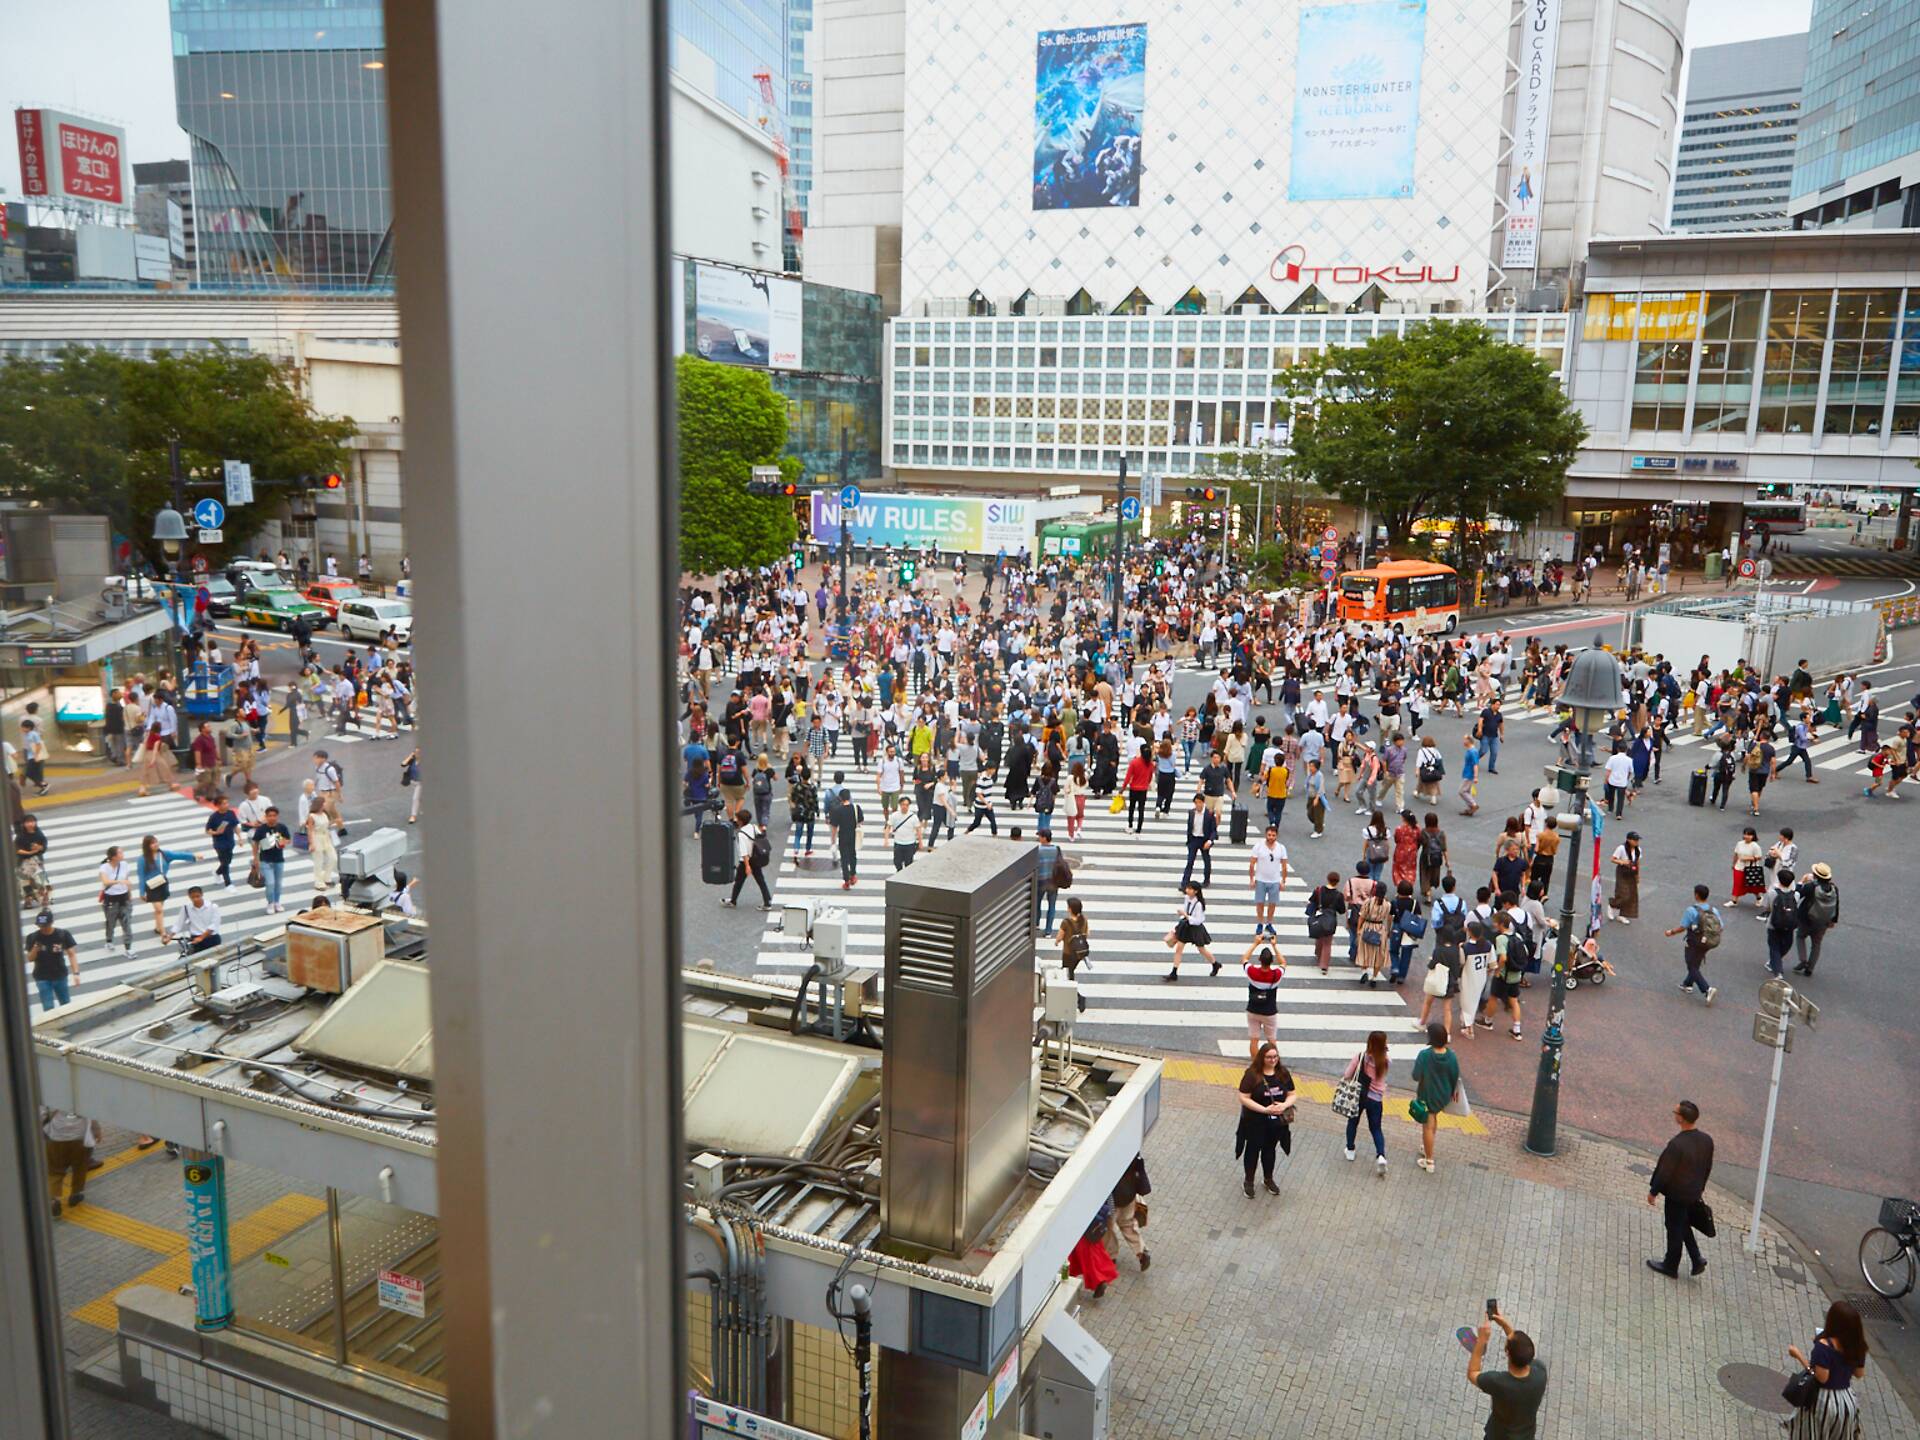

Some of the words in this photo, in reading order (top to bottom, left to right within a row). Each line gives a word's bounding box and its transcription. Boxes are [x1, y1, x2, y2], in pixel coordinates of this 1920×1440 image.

[1529, 36, 1544, 90] CARD
[1302, 83, 1361, 97] MONSTER
[1362, 80, 1413, 95] HUNTER
[61, 129, 117, 159] ほけんの
[1330, 138, 1377, 149] アイスボーン
[76, 155, 112, 179] 窓口
[72, 177, 114, 197] グループ
[1302, 264, 1459, 284] TOKYU
[884, 505, 974, 534] RULES.
[987, 503, 1025, 525] SIW
[1474, 954, 1487, 970] 21
[189, 1169, 201, 1182] 6
